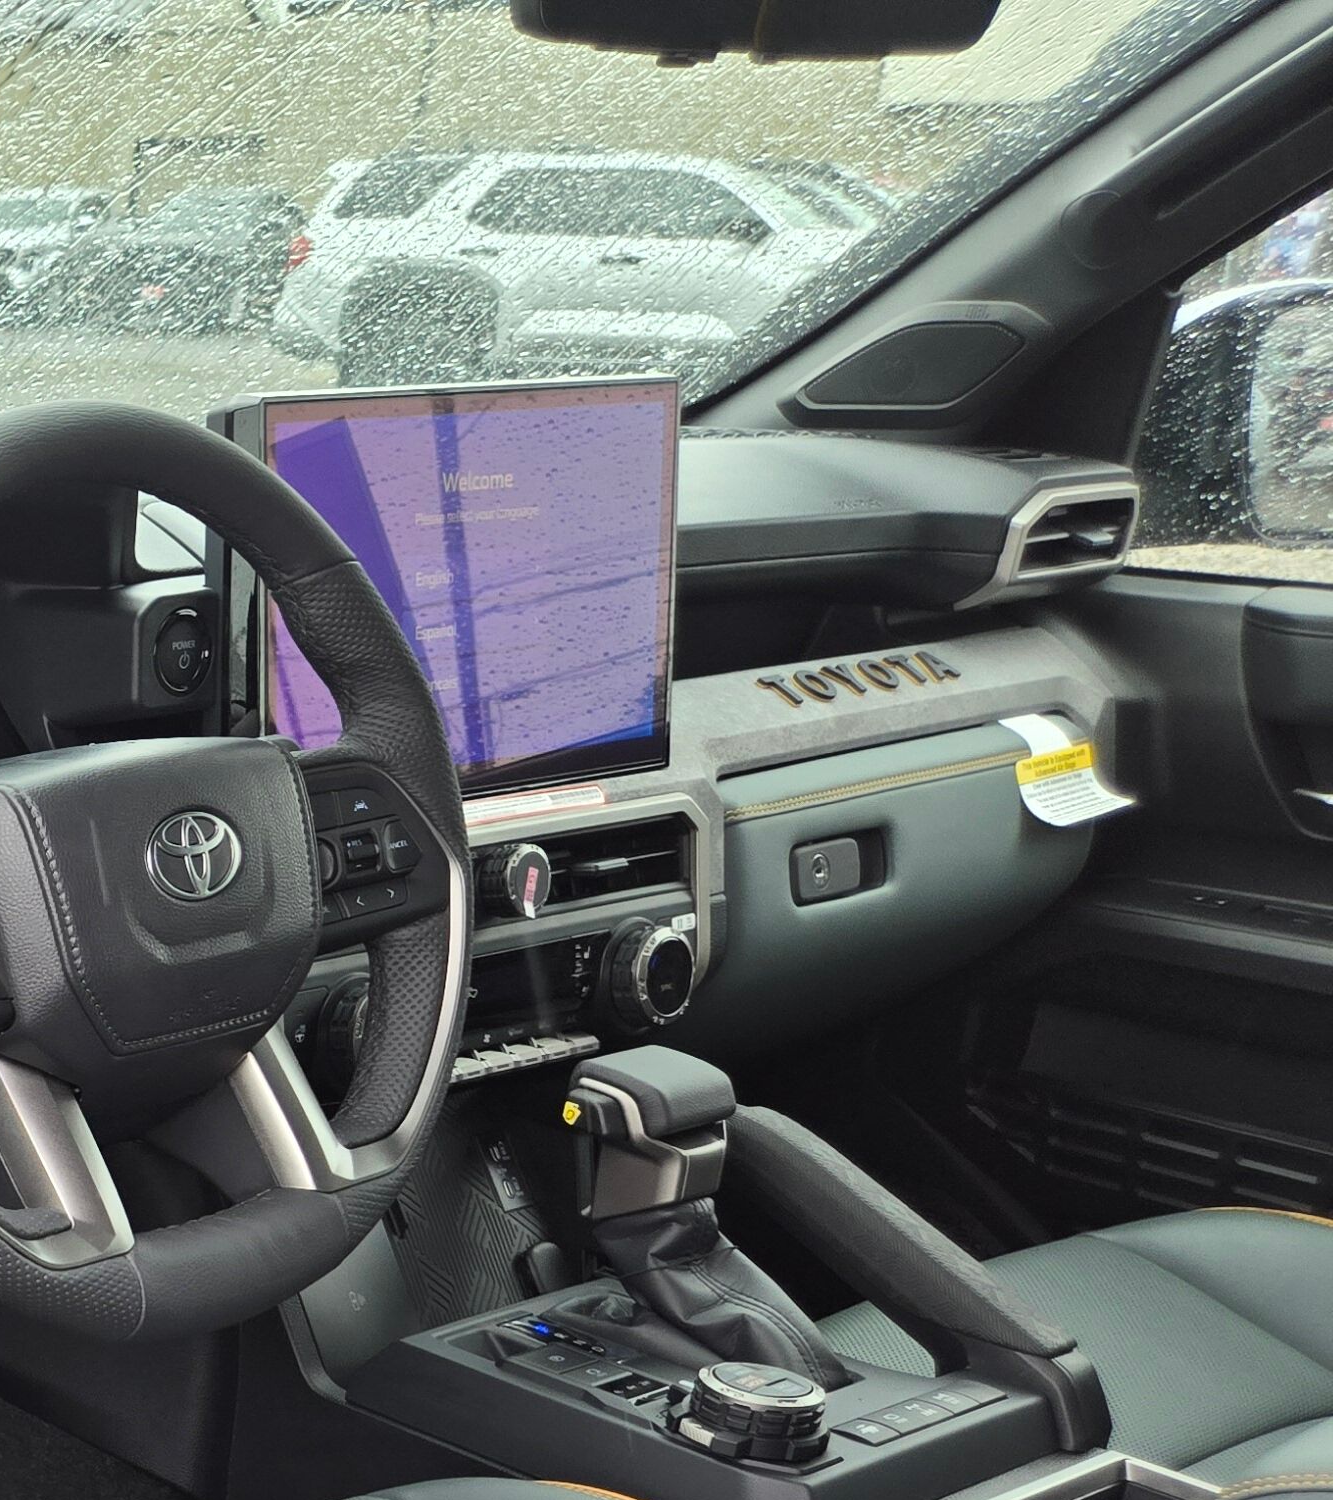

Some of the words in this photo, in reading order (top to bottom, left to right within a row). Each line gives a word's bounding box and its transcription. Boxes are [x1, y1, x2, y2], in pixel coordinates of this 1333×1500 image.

[442, 470, 515, 493] Welcome
[416, 570, 454, 589] English
[172, 640, 195, 651] POWER
[755, 650, 962, 708] TOYOTA
